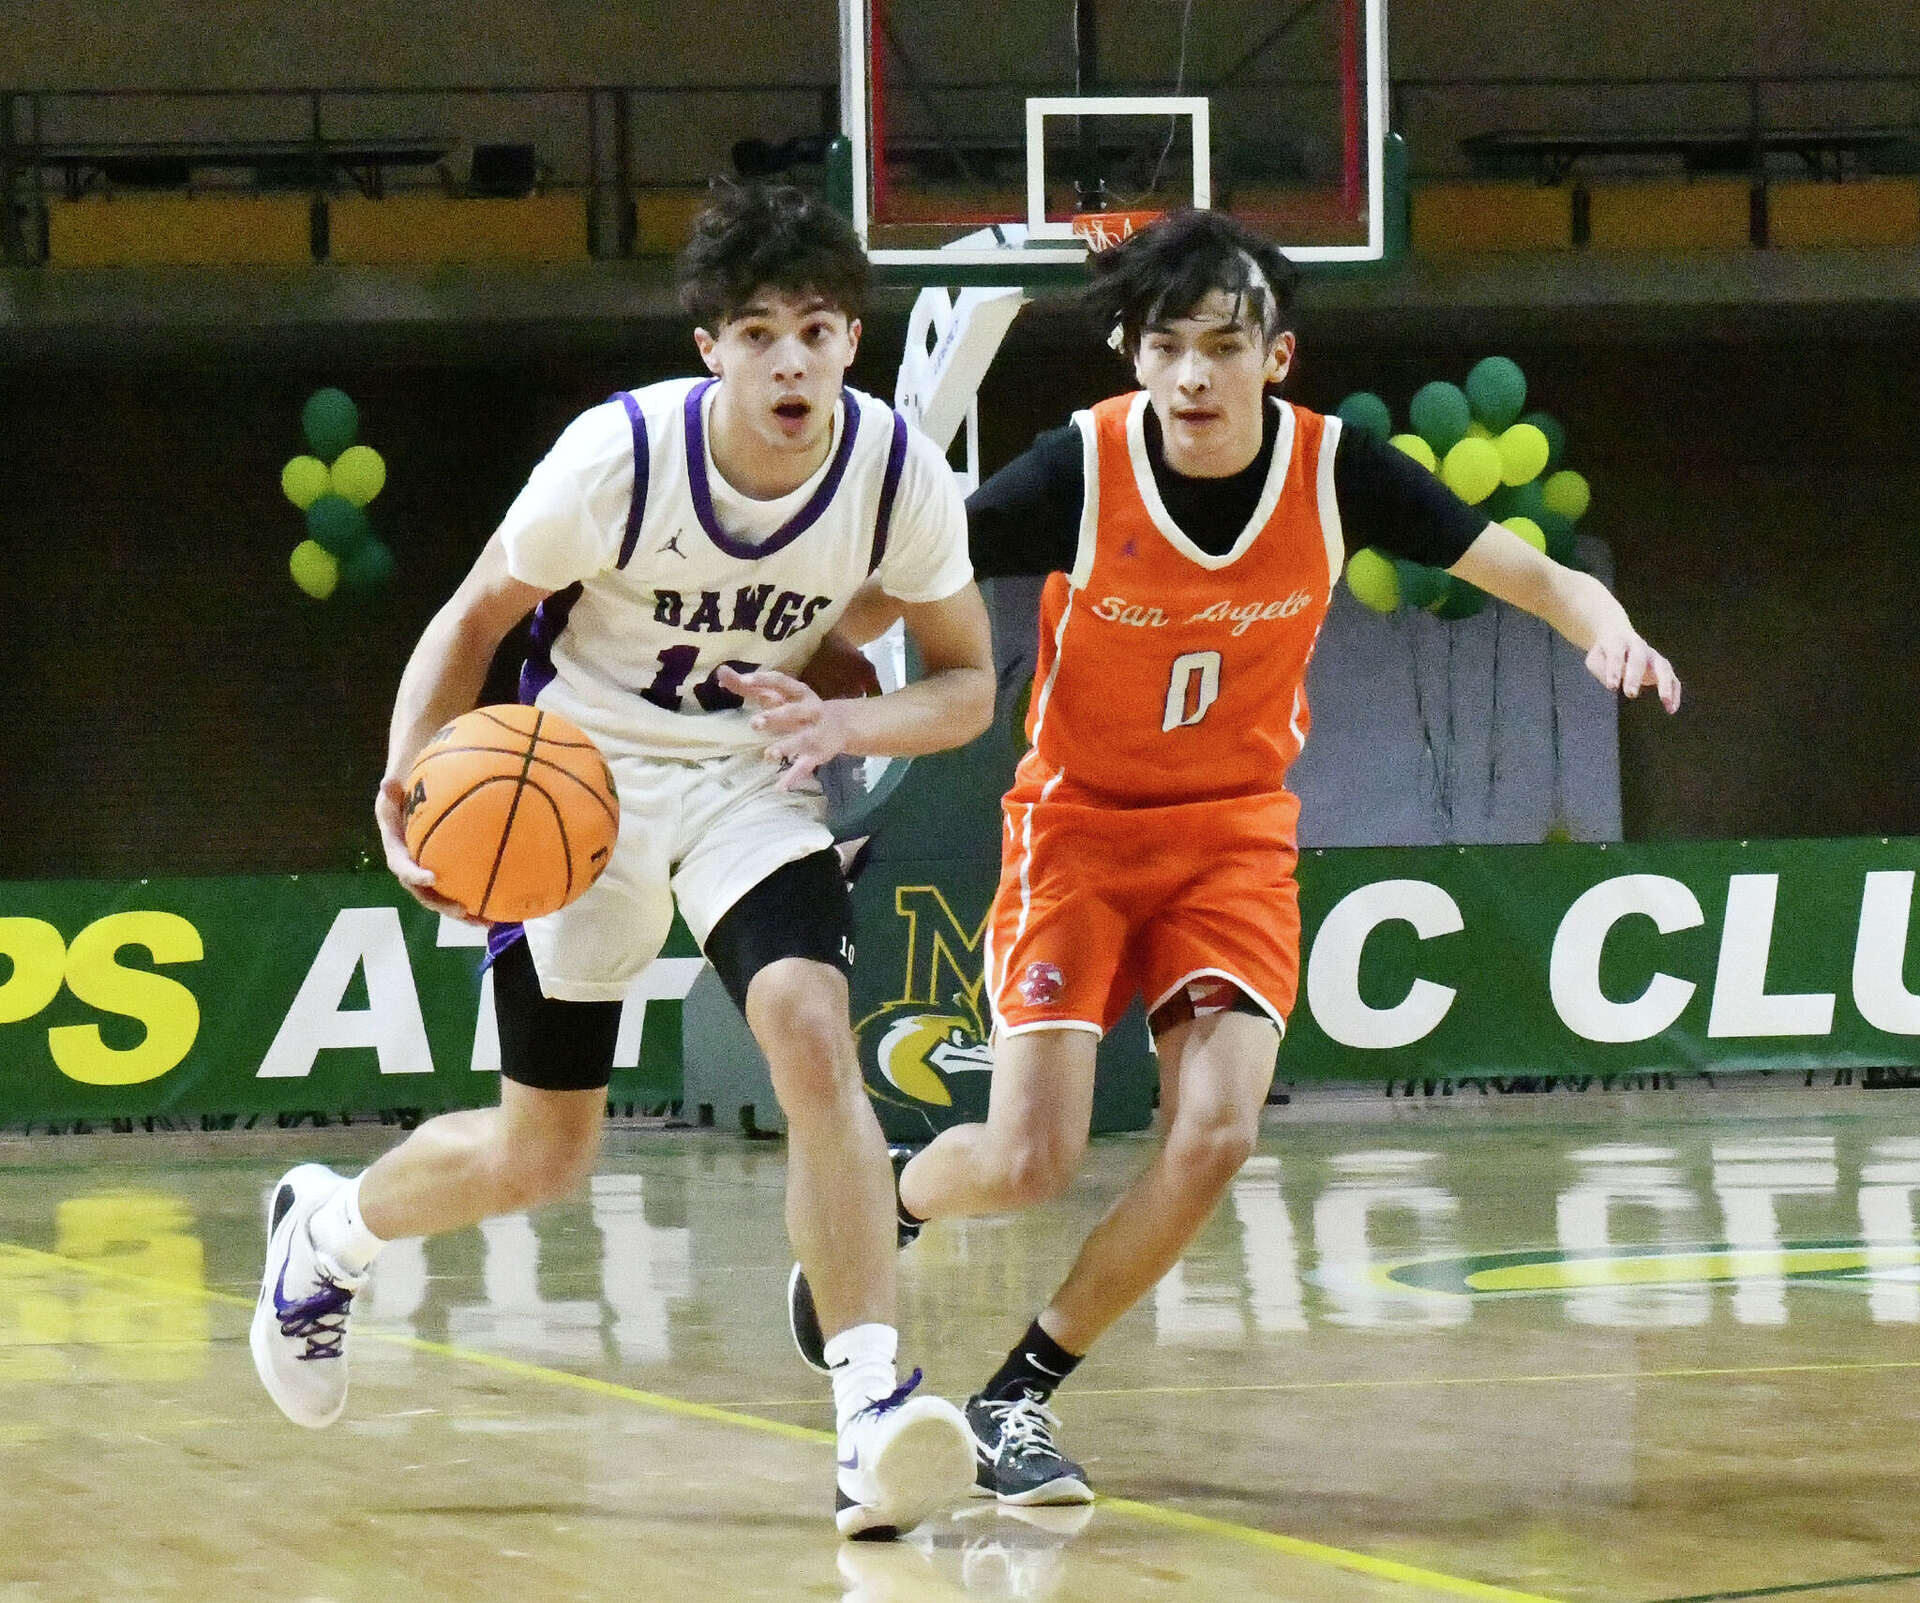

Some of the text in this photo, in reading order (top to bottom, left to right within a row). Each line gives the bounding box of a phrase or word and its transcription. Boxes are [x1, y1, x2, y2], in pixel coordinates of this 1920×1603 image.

[653, 584, 832, 642] DAWGS
[1092, 586, 1313, 636] San Angelo
[1162, 650, 1222, 733] 0
[839, 935, 855, 966] 10
